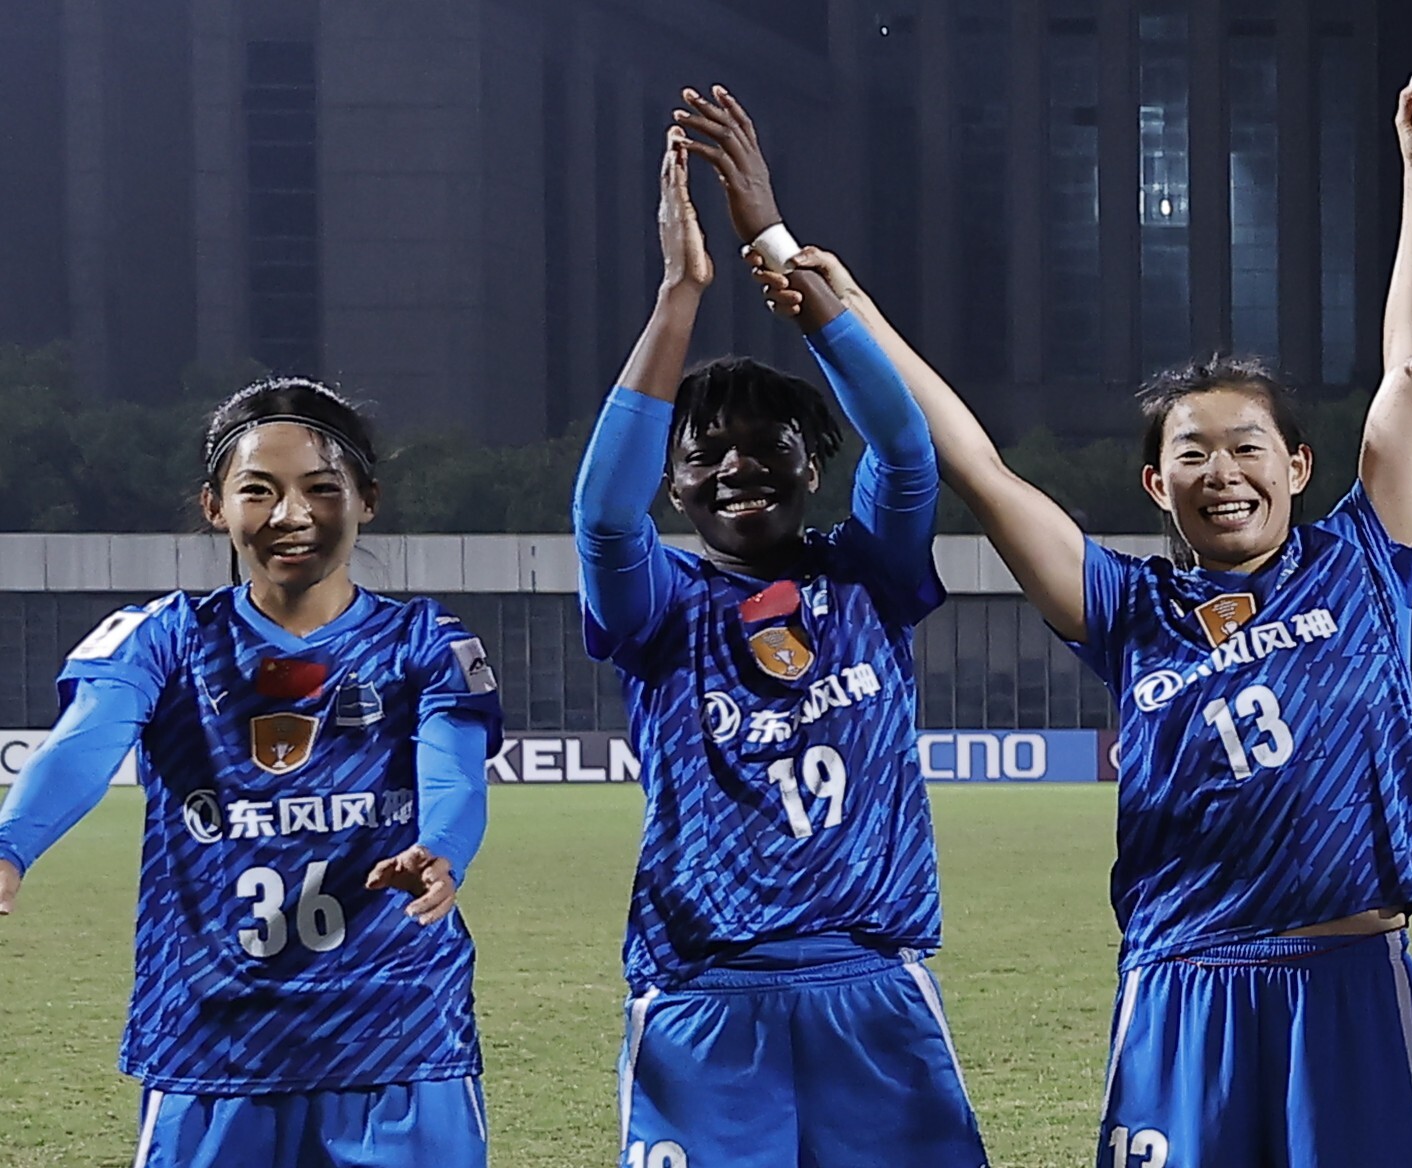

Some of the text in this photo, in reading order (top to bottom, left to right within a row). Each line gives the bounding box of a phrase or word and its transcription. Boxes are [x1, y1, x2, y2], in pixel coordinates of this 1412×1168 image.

[1186, 609, 1338, 683] 风风神
[747, 663, 882, 743] 东风神
[1203, 684, 1294, 780] 13
[228, 791, 414, 839] 东风风神
[767, 745, 847, 839] 19
[236, 861, 346, 958] 36
